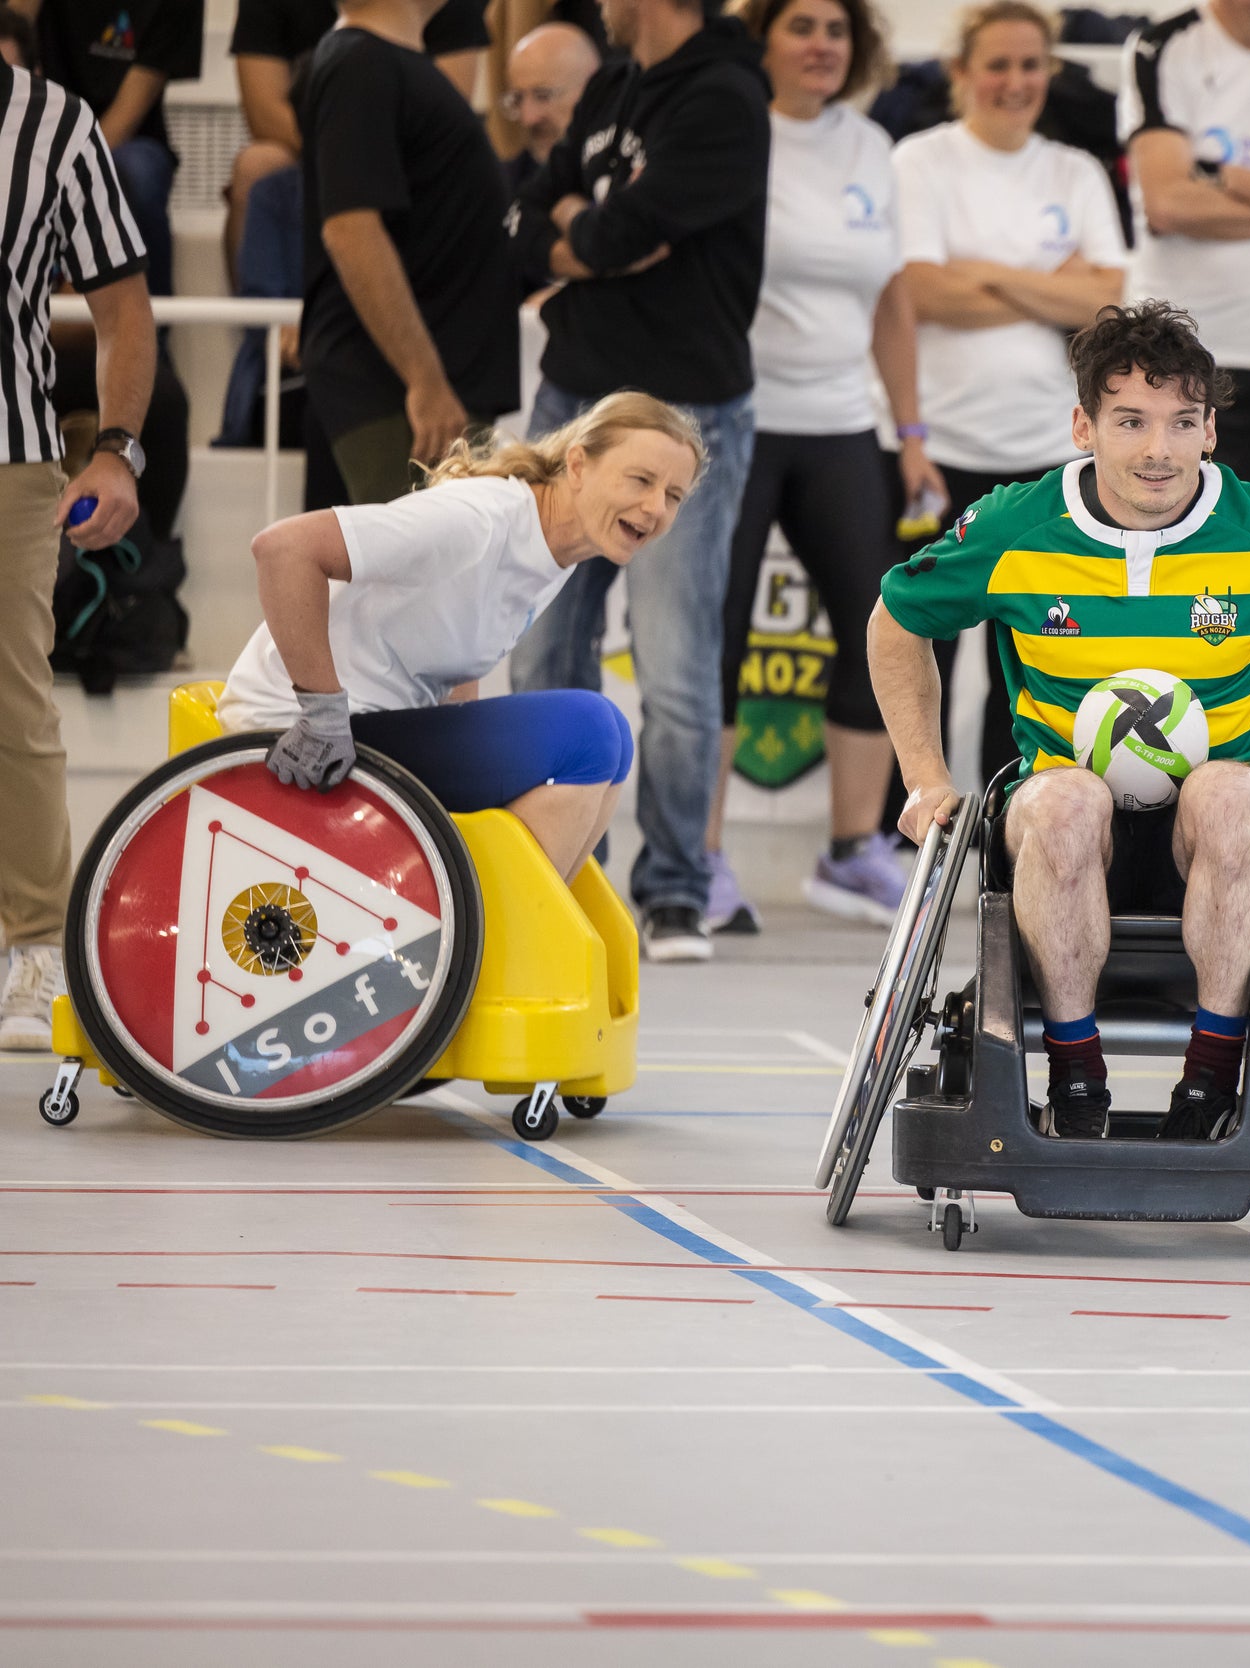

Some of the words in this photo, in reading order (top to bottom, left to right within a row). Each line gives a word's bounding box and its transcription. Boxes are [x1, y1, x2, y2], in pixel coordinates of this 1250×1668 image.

[1190, 613, 1238, 629] RUGBY
[1041, 627, 1048, 635] LE
[1048, 627, 1059, 635] COQ
[1059, 628, 1081, 636] SPORTIF
[1209, 627, 1231, 635] NOZAY
[738, 651, 828, 699] NOZ
